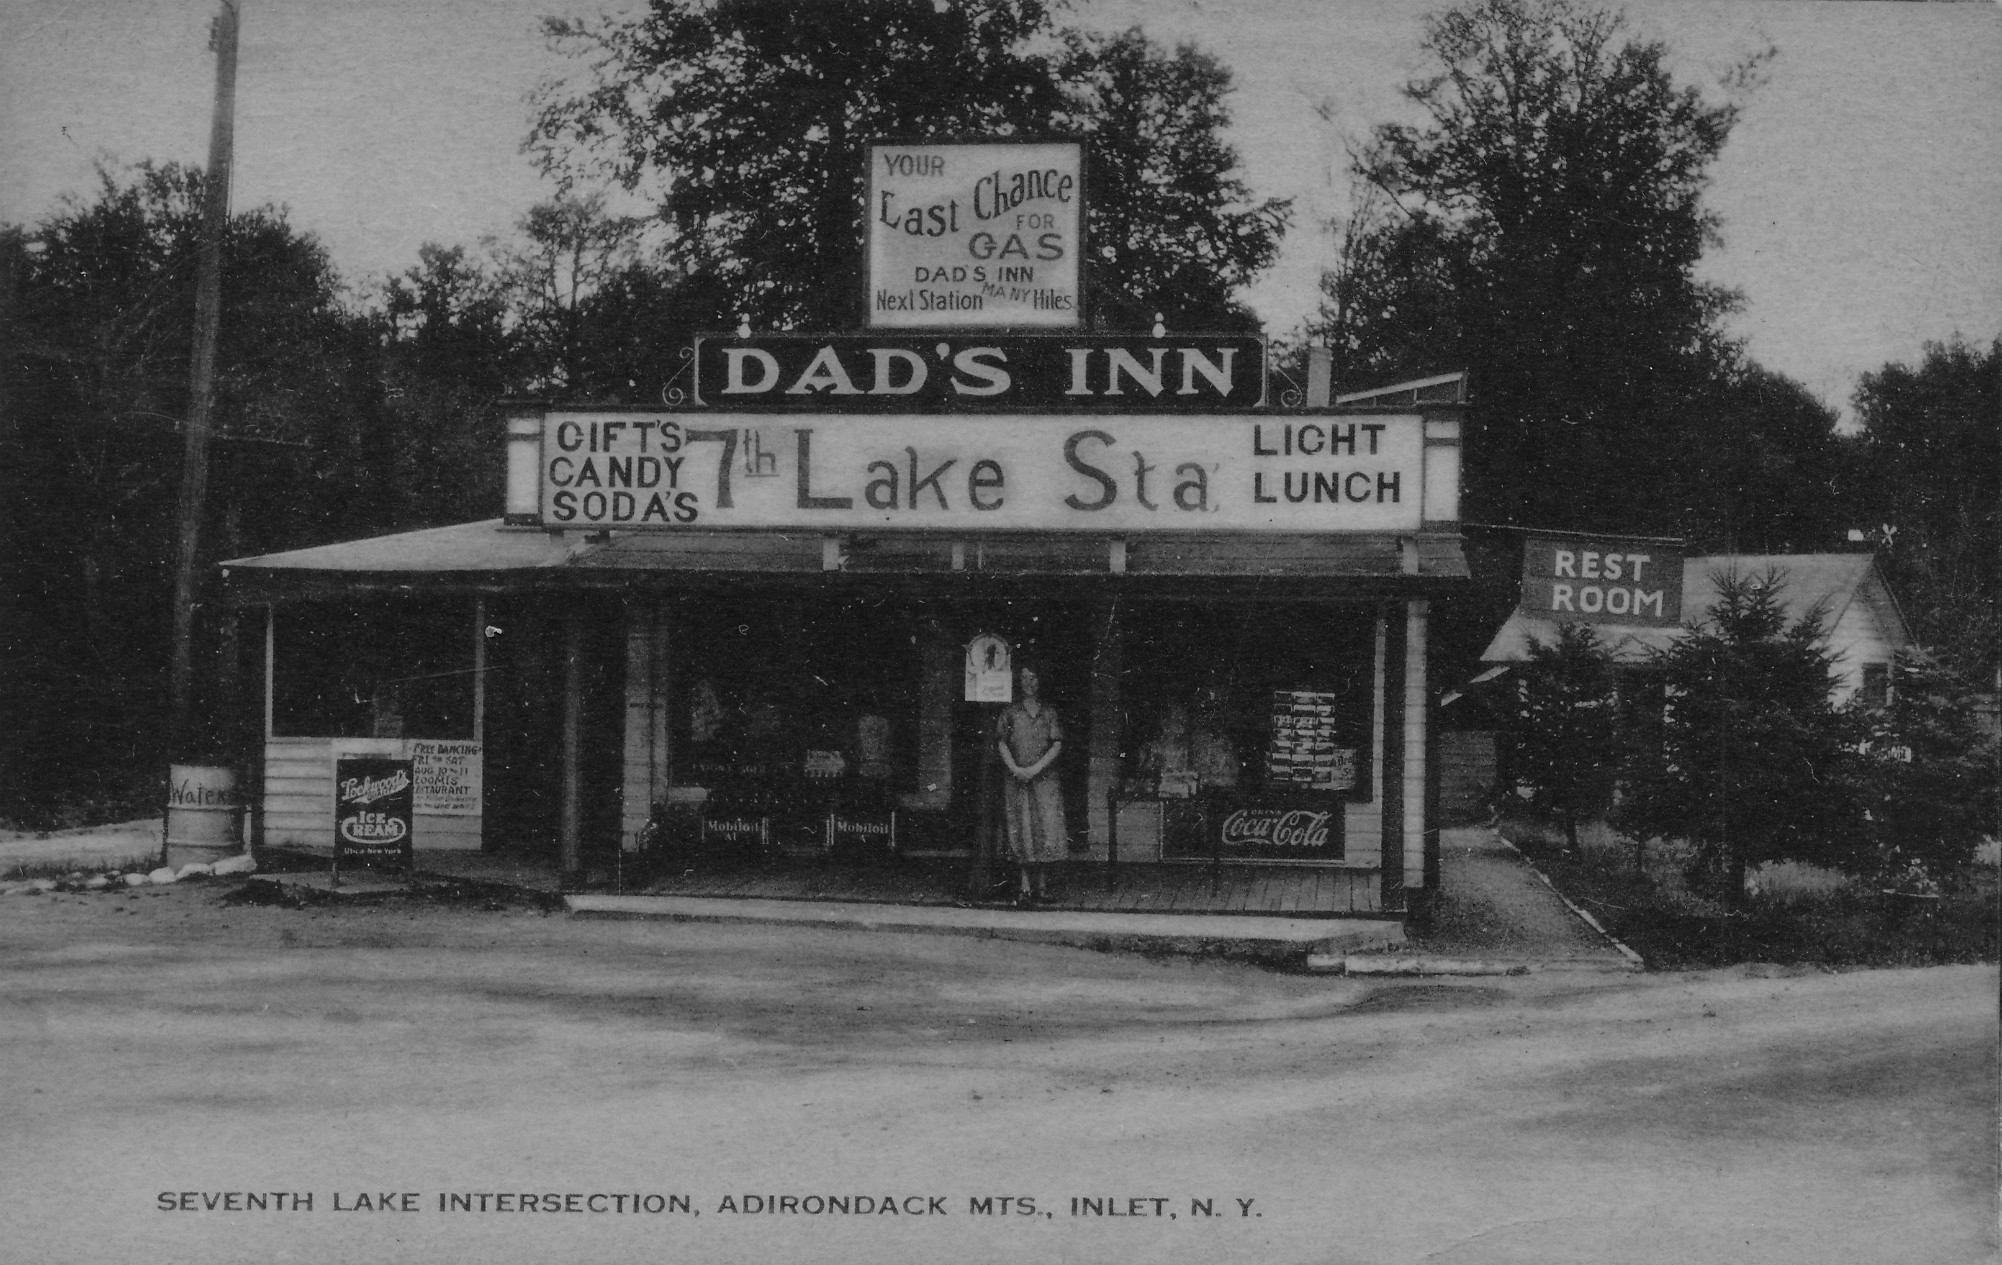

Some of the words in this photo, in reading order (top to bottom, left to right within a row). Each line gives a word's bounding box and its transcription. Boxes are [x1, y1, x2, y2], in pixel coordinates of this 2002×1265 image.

[884, 153, 945, 177] YOUR
[879, 189, 960, 238] Last
[973, 168, 1073, 220] Chance
[1016, 213, 1055, 231] FOR
[968, 231, 1064, 261] GAS
[998, 266, 1034, 283] INN
[919, 289, 983, 311] Station
[982, 282, 1031, 301] MANY
[721, 342, 1012, 397] DAD'S
[1064, 347, 1239, 398] INN
[557, 419, 681, 453] GIFT'S
[1254, 423, 1386, 457] LIGHT
[548, 456, 685, 488] CANDY
[685, 428, 779, 509] 7th
[794, 428, 1005, 511] Lake
[1254, 471, 1401, 504] LUNCH
[552, 490, 699, 523] SODA'S
[1554, 550, 1651, 582] REST
[1551, 584, 1663, 618] ROOM
[359, 811, 386, 824] ICE
